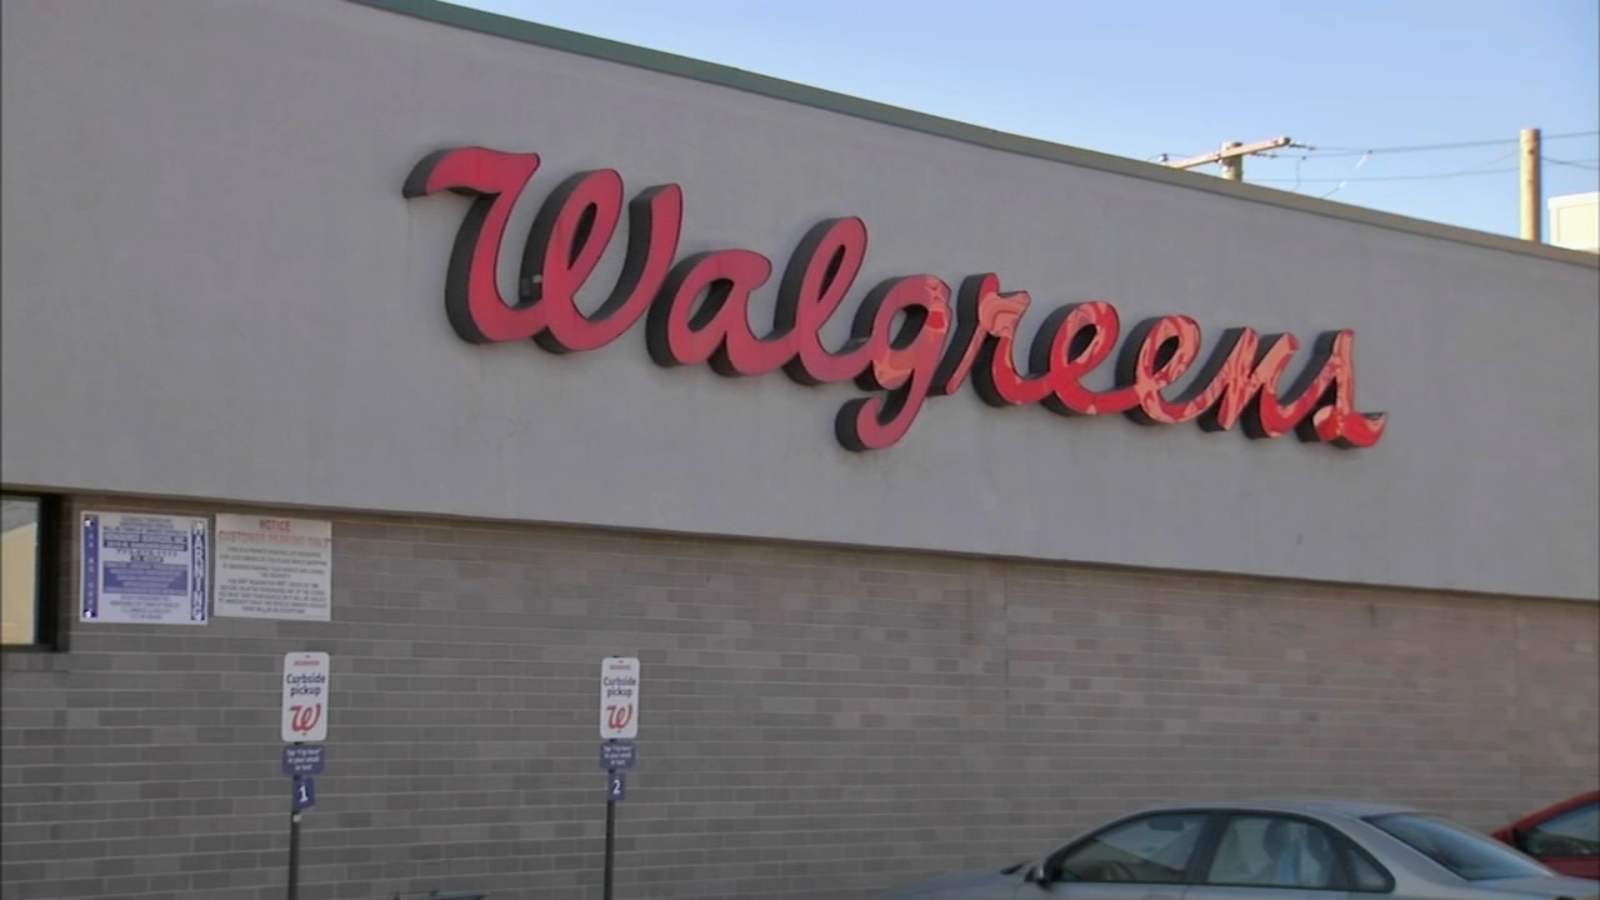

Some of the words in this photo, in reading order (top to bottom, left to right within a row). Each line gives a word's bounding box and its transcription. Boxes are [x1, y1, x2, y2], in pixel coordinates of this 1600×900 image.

[403, 145, 1388, 451] Walgreens
[260, 520, 291, 532] NOTICE
[219, 530, 266, 541] CUSTOMER
[286, 673, 326, 685] Curbside
[604, 676, 636, 687] Curbside
[290, 684, 321, 698] pickup
[607, 687, 632, 698] pickup
[289, 703, 321, 732] W
[606, 704, 632, 729] W
[299, 785, 309, 803] 1
[613, 779, 621, 795] 2
